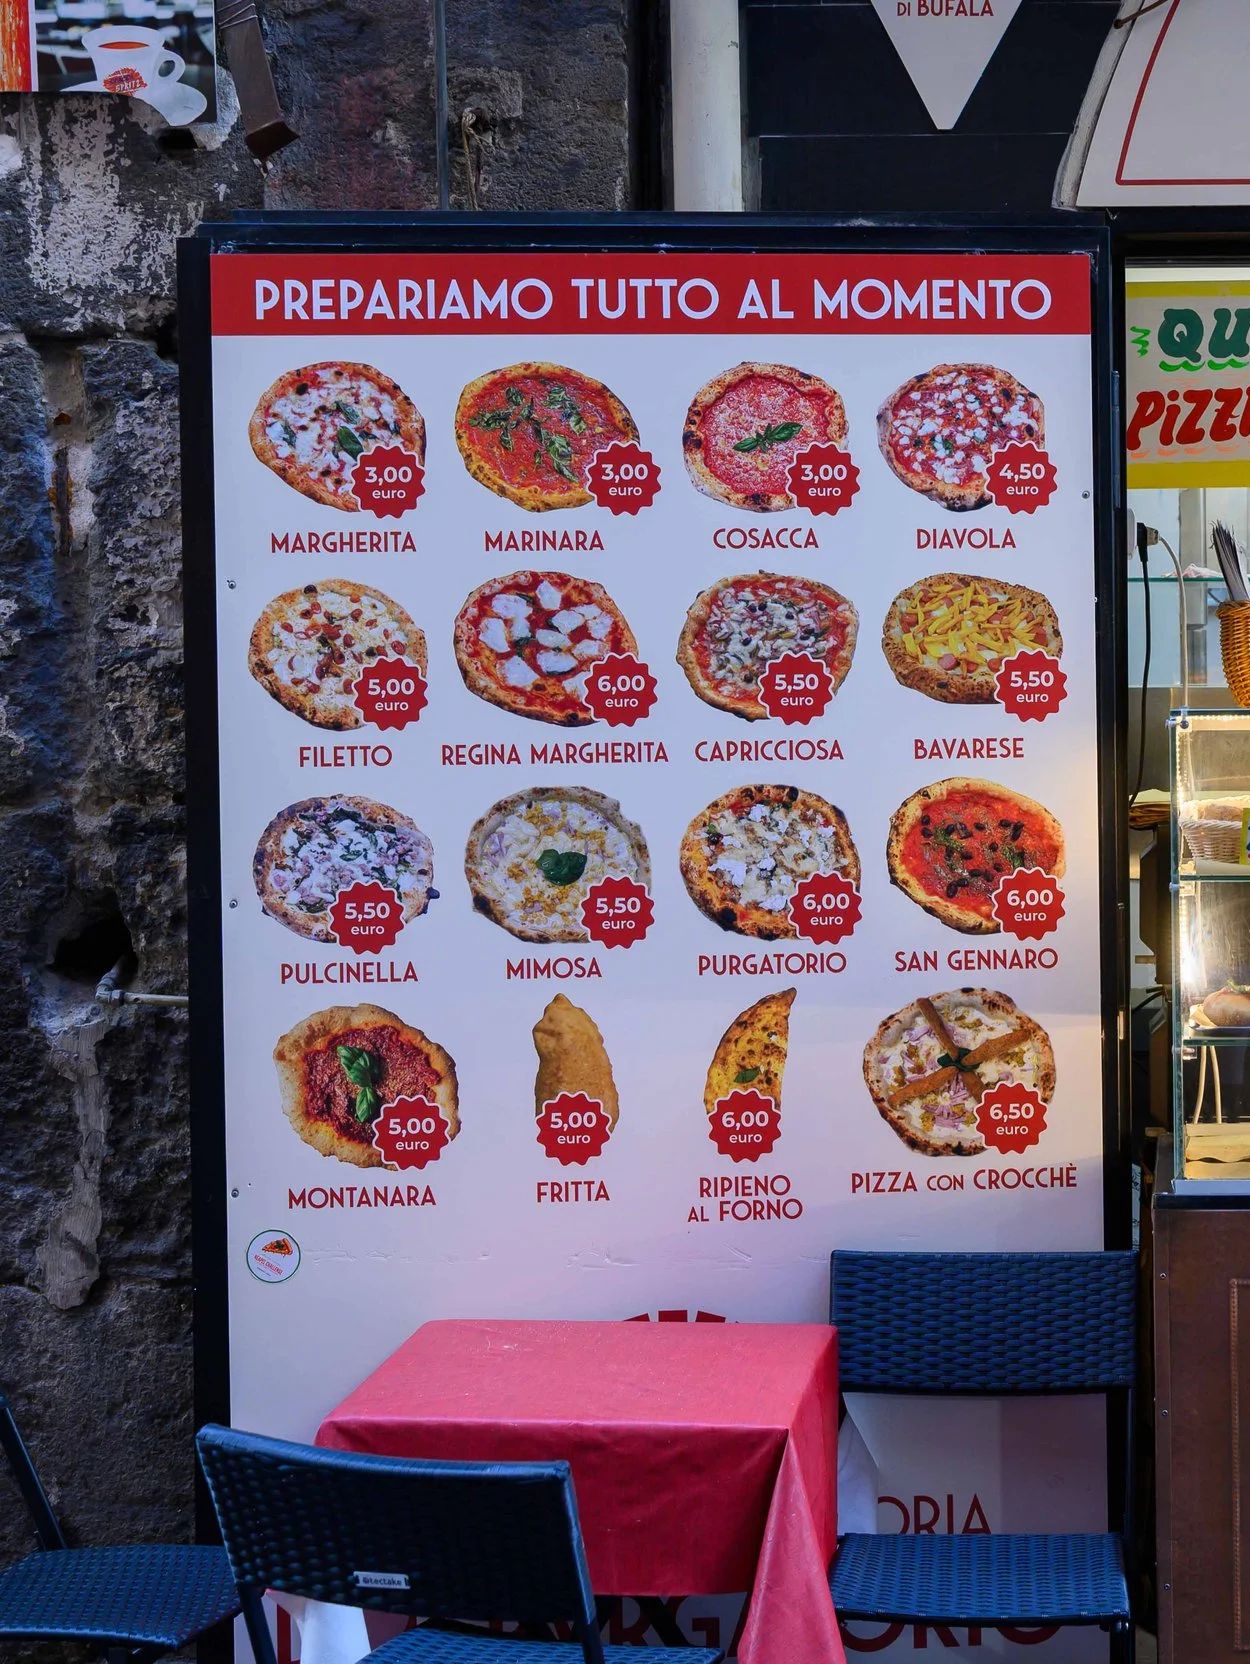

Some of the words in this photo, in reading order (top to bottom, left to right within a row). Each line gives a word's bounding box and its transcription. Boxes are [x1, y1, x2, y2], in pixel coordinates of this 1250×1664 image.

[897, 2, 911, 16] DI
[917, 0, 994, 17] BUFALA
[255, 278, 553, 320] PREPARIAMO
[571, 278, 719, 320] TUTTO
[738, 279, 795, 319] AL
[814, 278, 1052, 320] MOMENTO
[364, 466, 412, 486] 3,00
[601, 463, 648, 483] 3,00
[800, 464, 848, 484] 3,00
[999, 462, 1046, 482] 4,50
[372, 487, 406, 500] euro
[608, 484, 642, 497] euro
[808, 485, 842, 497] euro
[1005, 485, 1039, 496] euro
[271, 530, 417, 554] MARGHERITA
[484, 530, 605, 552] MARINARA
[713, 527, 819, 549] COSACCA
[916, 527, 1017, 549] DIAVOLA
[367, 679, 415, 699] 5,00
[597, 675, 645, 695] 6,00
[774, 674, 819, 694] 5,50
[1010, 671, 1054, 690] 5,50
[375, 700, 409, 712] euro
[604, 696, 639, 709] euro
[780, 694, 814, 707] euro
[1016, 691, 1049, 704] euro
[299, 745, 393, 768] FILETTO
[441, 743, 521, 767] REGINA
[530, 741, 669, 765] MARGHERITA
[694, 739, 844, 763] CAPRICCIOSA
[914, 738, 1025, 760] BAVARESE
[595, 898, 641, 917] 5,50
[802, 893, 850, 913] 6,00
[1006, 890, 1053, 910] 6,00
[344, 902, 390, 922] 5,50
[810, 914, 843, 926] euro
[1013, 910, 1047, 922] euro
[351, 923, 385, 936] euro
[601, 918, 635, 930] euro
[506, 957, 602, 980] MIMOSA
[698, 952, 847, 976] PURGATORIO
[895, 950, 939, 972] SAN
[947, 948, 1059, 971] GENNARO
[280, 961, 418, 985] PULCINELLA
[550, 1112, 597, 1131] 5,00
[721, 1111, 769, 1130] 6,00
[989, 1103, 1035, 1122] 6,50
[388, 1118, 436, 1137] 5,00
[996, 1124, 1029, 1136] euro
[395, 1139, 429, 1151] euro
[557, 1133, 591, 1145] euro
[729, 1132, 762, 1144] euro
[699, 1175, 791, 1198] RIPIENO
[851, 1172, 918, 1193] PIZZA
[927, 1174, 964, 1191] CON
[973, 1163, 1077, 1190] CROCCHÈ
[288, 1185, 436, 1209] MONTANARA
[536, 1181, 610, 1203] FRITTA
[687, 1206, 709, 1223] AL
[719, 1198, 803, 1221] FORNO
